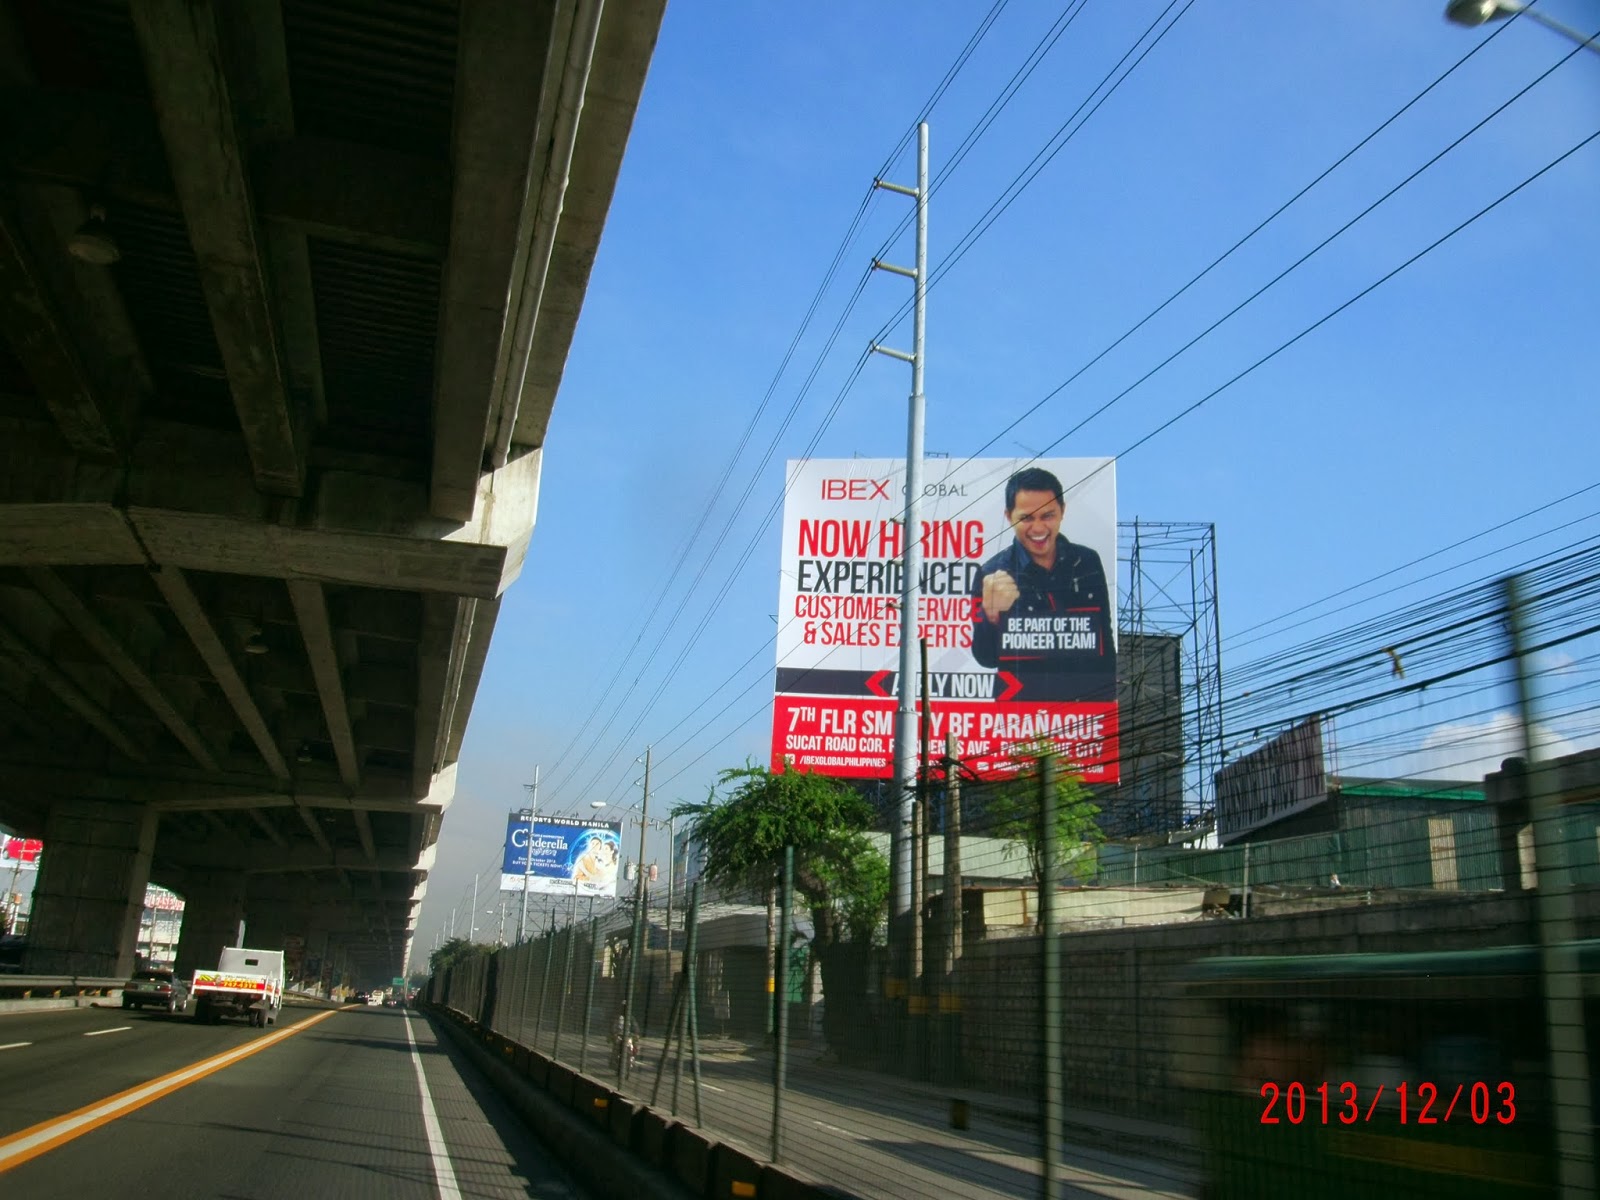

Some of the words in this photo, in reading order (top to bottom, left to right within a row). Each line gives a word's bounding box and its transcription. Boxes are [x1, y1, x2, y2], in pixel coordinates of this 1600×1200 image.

[821, 479, 891, 501] IBEX
[902, 483, 968, 497] OBAL
[799, 519, 871, 558] NOW
[795, 594, 898, 622] CUSTOMER
[917, 597, 984, 623] ERVICE
[804, 621, 816, 645] &
[821, 622, 880, 647] SALES
[1008, 617, 1022, 631] BE
[1024, 617, 1051, 632] PART
[1054, 617, 1068, 632] OF
[1069, 617, 1091, 632] THE
[1002, 633, 1055, 649] PIONEER
[1057, 633, 1096, 649] TEAM!
[891, 672, 948, 697] ALY
[952, 674, 995, 698] NOW
[787, 706, 816, 733] 7TH
[820, 708, 857, 735] FLR
[861, 710, 893, 736] SM
[949, 712, 975, 739] BF
[980, 709, 1105, 741] PARAÑAQUE
[785, 734, 823, 751] SUCAT
[825, 736, 857, 752] ROAD
[859, 738, 886, 754] COR.
[554, 818, 580, 826] WORLD
[581, 821, 609, 829] MANILA
